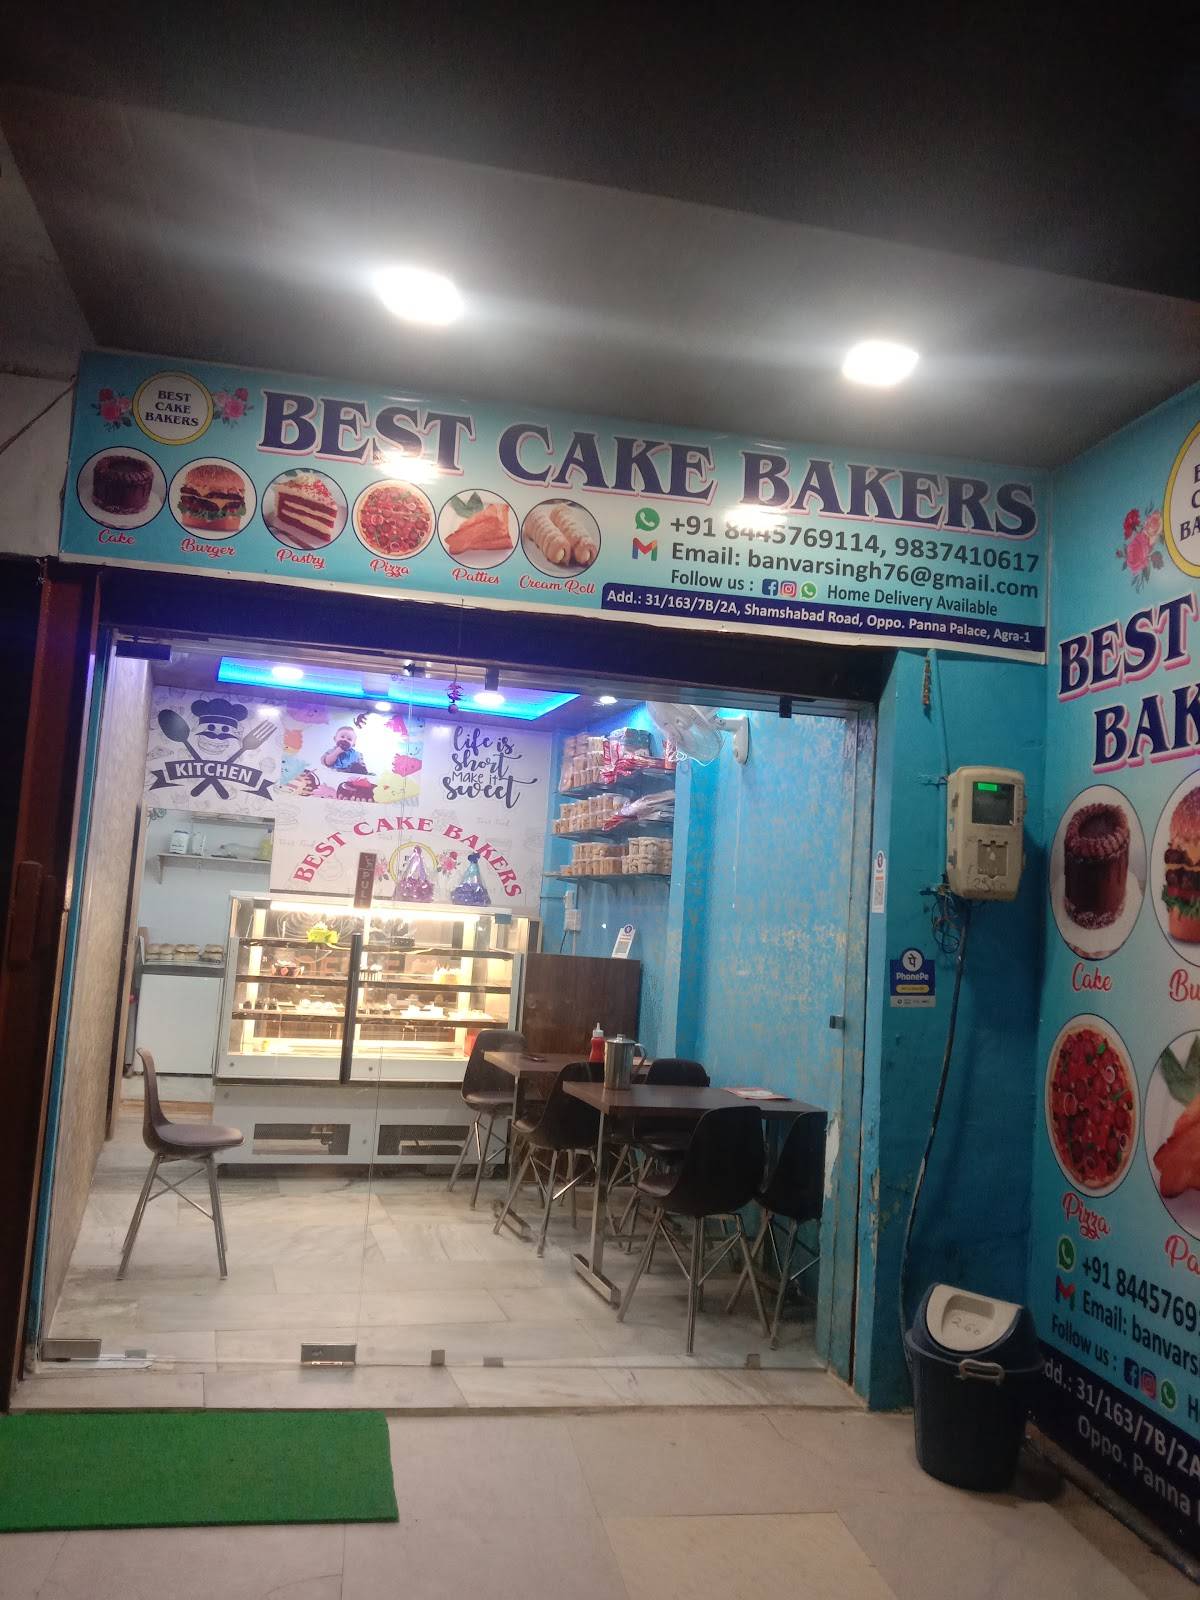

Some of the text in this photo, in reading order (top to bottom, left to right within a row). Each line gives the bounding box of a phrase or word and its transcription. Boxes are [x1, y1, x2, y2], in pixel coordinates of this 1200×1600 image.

[155, 401, 191, 414] CAKE
[158, 389, 191, 402] BEST
[145, 411, 199, 427] BAKERS
[257, 389, 1039, 541] BEST CAKE BAKERS
[98, 529, 136, 545] Cake
[180, 537, 236, 559] Burger
[670, 515, 717, 538] +91
[894, 537, 1040, 573] 9837410617
[276, 548, 326, 570] Pastry
[370, 558, 410, 578] Pizza
[672, 542, 1039, 598] Email: banvarsingh76@gmail.com
[452, 567, 500, 586] Patties
[519, 574, 596, 596] Cream Roll
[671, 569, 724, 589] Follow
[727, 576, 745, 591] us
[827, 585, 998, 616] Home Delivery Available
[607, 589, 1031, 644] Add.: 31/163/7B/2A, Shamshabad Road, Oppo. Panna Palace, Agra-1
[1057, 592, 1199, 703] BEST
[174, 761, 253, 783] KITCHEN
[292, 815, 523, 898] BEST CAKE BAKERS
[896, 972, 929, 981] PhonePe
[1071, 961, 1113, 992] Cake
[1062, 1191, 1110, 1240] Pizza
[1082, 1256, 1200, 1337] +91 8445769
[1083, 1289, 1127, 1336] Email:
[1052, 1313, 1092, 1355] Follow
[1095, 1343, 1109, 1367] us
[1042, 1357, 1072, 1393] dd.:
[1078, 1414, 1128, 1468] Oppo.
[1133, 1452, 1191, 1517] Panna
